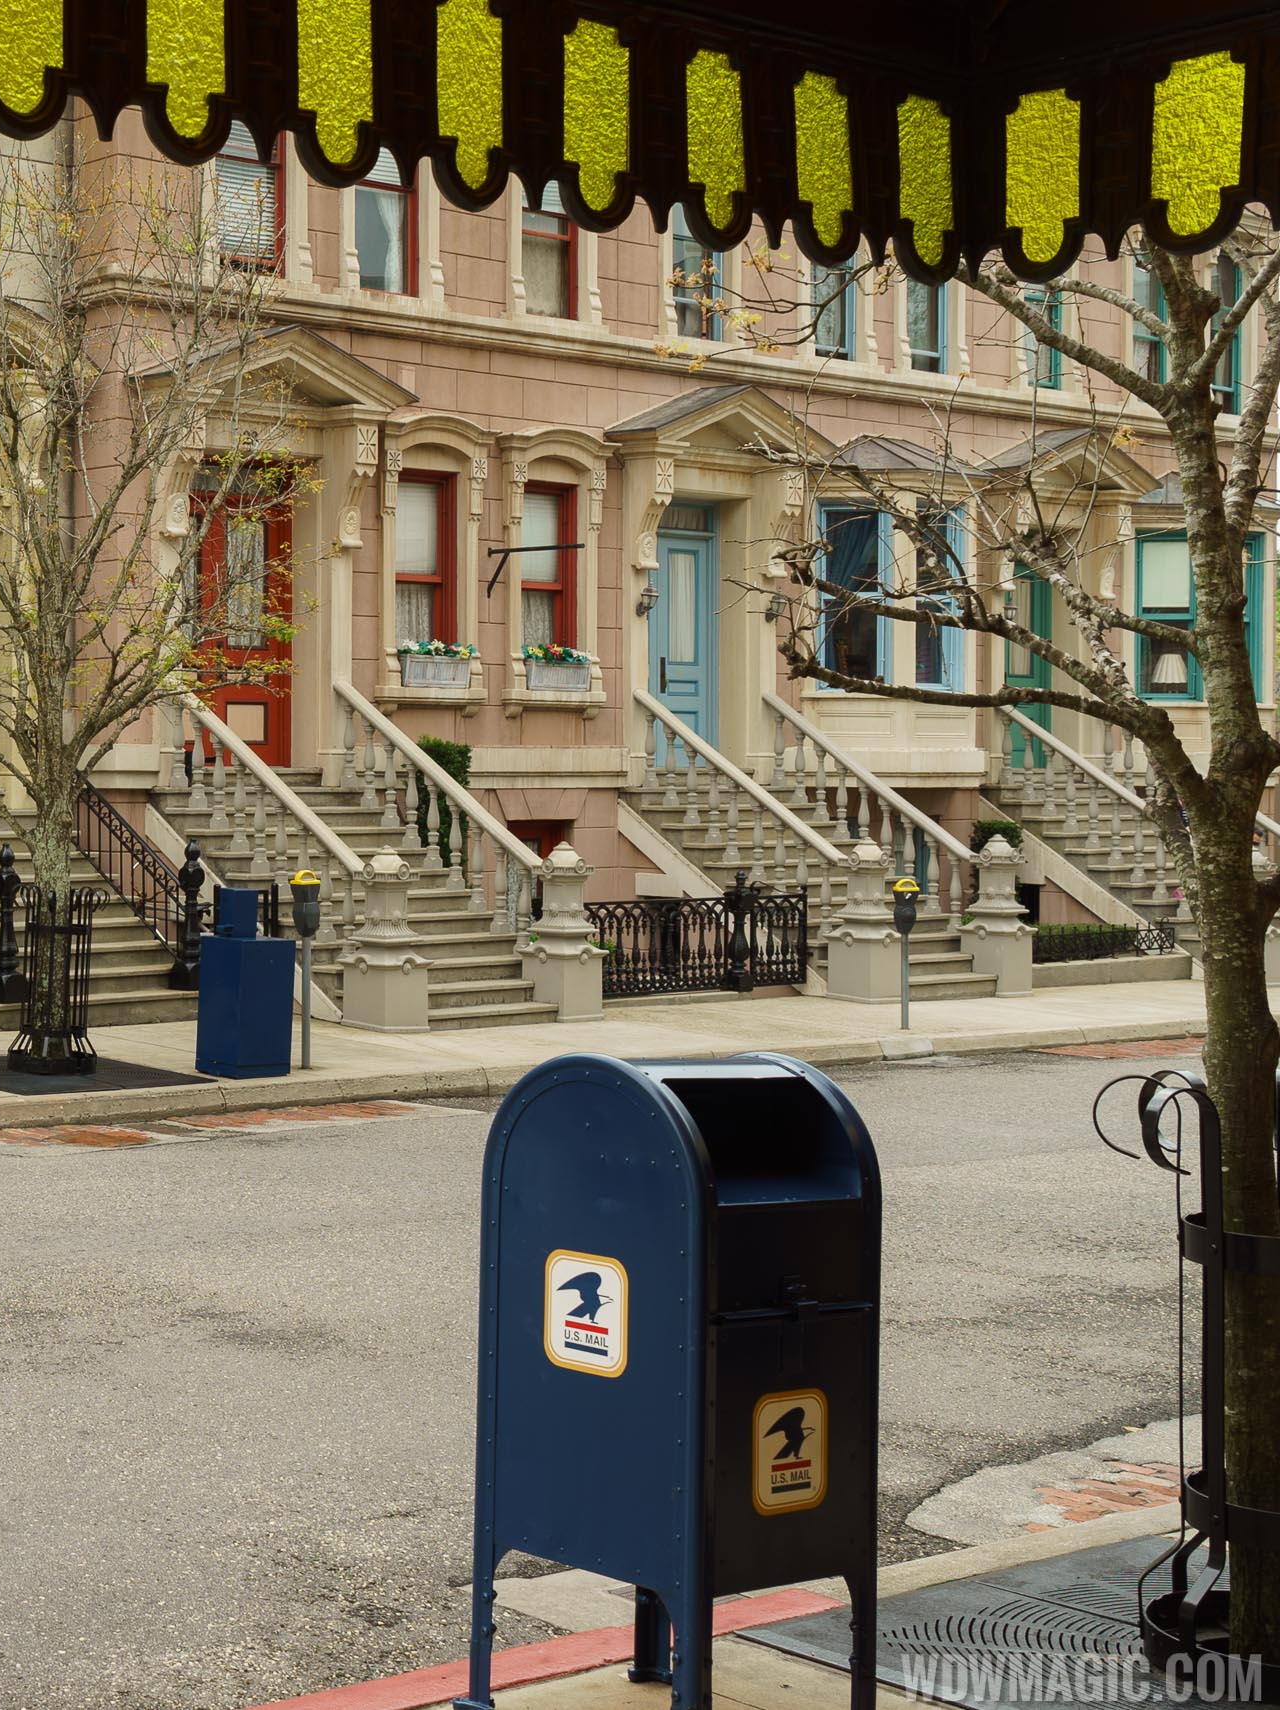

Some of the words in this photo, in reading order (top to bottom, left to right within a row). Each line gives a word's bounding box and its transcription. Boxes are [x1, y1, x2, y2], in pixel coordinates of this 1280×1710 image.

[564, 1330, 583, 1343] U.S.
[585, 1333, 609, 1348] MAIL
[770, 1473, 789, 1485] U.S.
[790, 1469, 812, 1482] MAIL
